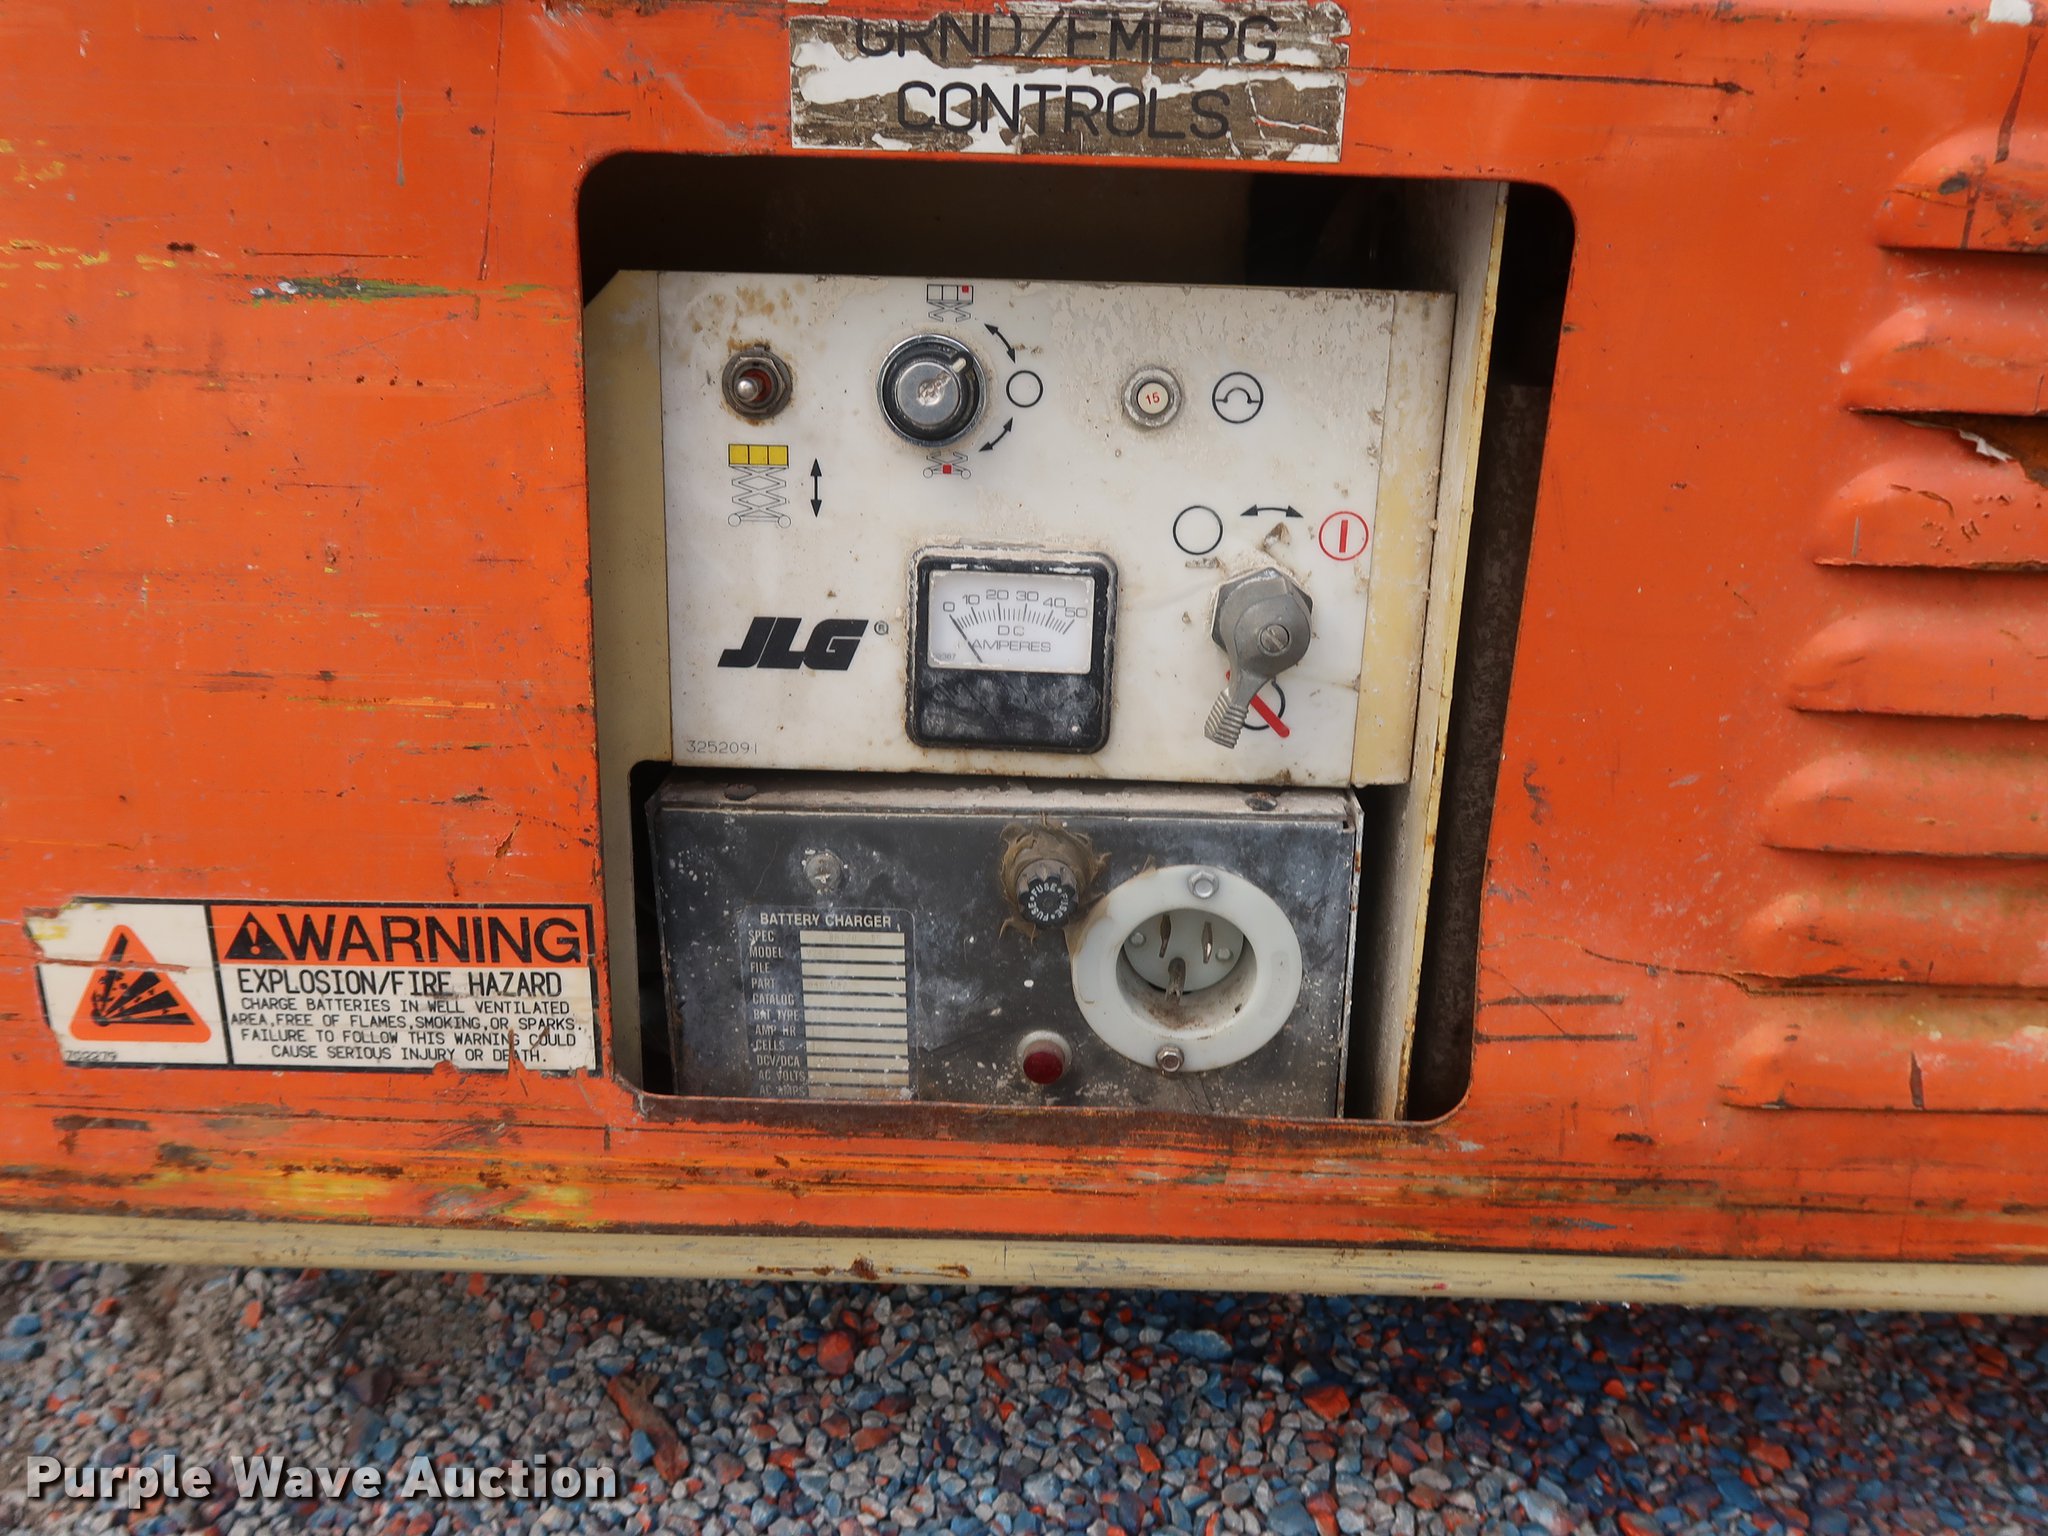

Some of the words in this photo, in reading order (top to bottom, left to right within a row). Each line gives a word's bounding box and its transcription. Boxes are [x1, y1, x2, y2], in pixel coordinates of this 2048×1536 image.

[899, 81, 1231, 139] CONTROLS
[1145, 391, 1160, 405] 15
[962, 594, 981, 605] 10
[986, 589, 1010, 600] 20
[1016, 590, 1039, 602] 30
[942, 601, 955, 612] 0
[1043, 597, 1066, 608] 40
[1064, 607, 1088, 618] 50
[971, 639, 1051, 652] AMPERES
[1031, 882, 1057, 897] FUSE
[760, 913, 820, 926] BATTERY
[825, 914, 891, 928] CHARGER
[276, 912, 581, 963] WARNING
[748, 930, 775, 942] SPEC
[750, 947, 783, 959] MODEL
[750, 962, 770, 974] FILE
[237, 968, 452, 996] EXPLOSION/FIRE
[468, 971, 562, 997] HAZARD
[751, 977, 776, 989] PART
[752, 993, 795, 1005] CATALOG
[241, 997, 297, 1011] CHARGE
[306, 998, 391, 1012] BATTERIES
[401, 1000, 418, 1013] IN
[427, 1001, 465, 1014] WELL
[475, 1001, 570, 1015] VENTILATED
[322, 1014, 340, 1027] OF
[518, 1017, 582, 1031] SPARKS.
[755, 1024, 777, 1036] AMP
[241, 1028, 306, 1042] FAILURE
[316, 1029, 334, 1042] TO
[343, 1030, 399, 1044] FOLLOW
[409, 1031, 445, 1045] THIS
[455, 1032, 520, 1046] WARNING
[529, 1033, 576, 1047] COULD
[755, 1039, 785, 1051] CELLS
[272, 1045, 318, 1059] CAUSE
[327, 1046, 391, 1060] SERIOUS
[401, 1047, 455, 1061] INJURY
[465, 1048, 484, 1061] OR
[493, 1048, 547, 1062] DEATH.
[756, 1055, 800, 1067] DCV/DCA
[758, 1069, 771, 1081] AC
[776, 1070, 806, 1082] VOLTS
